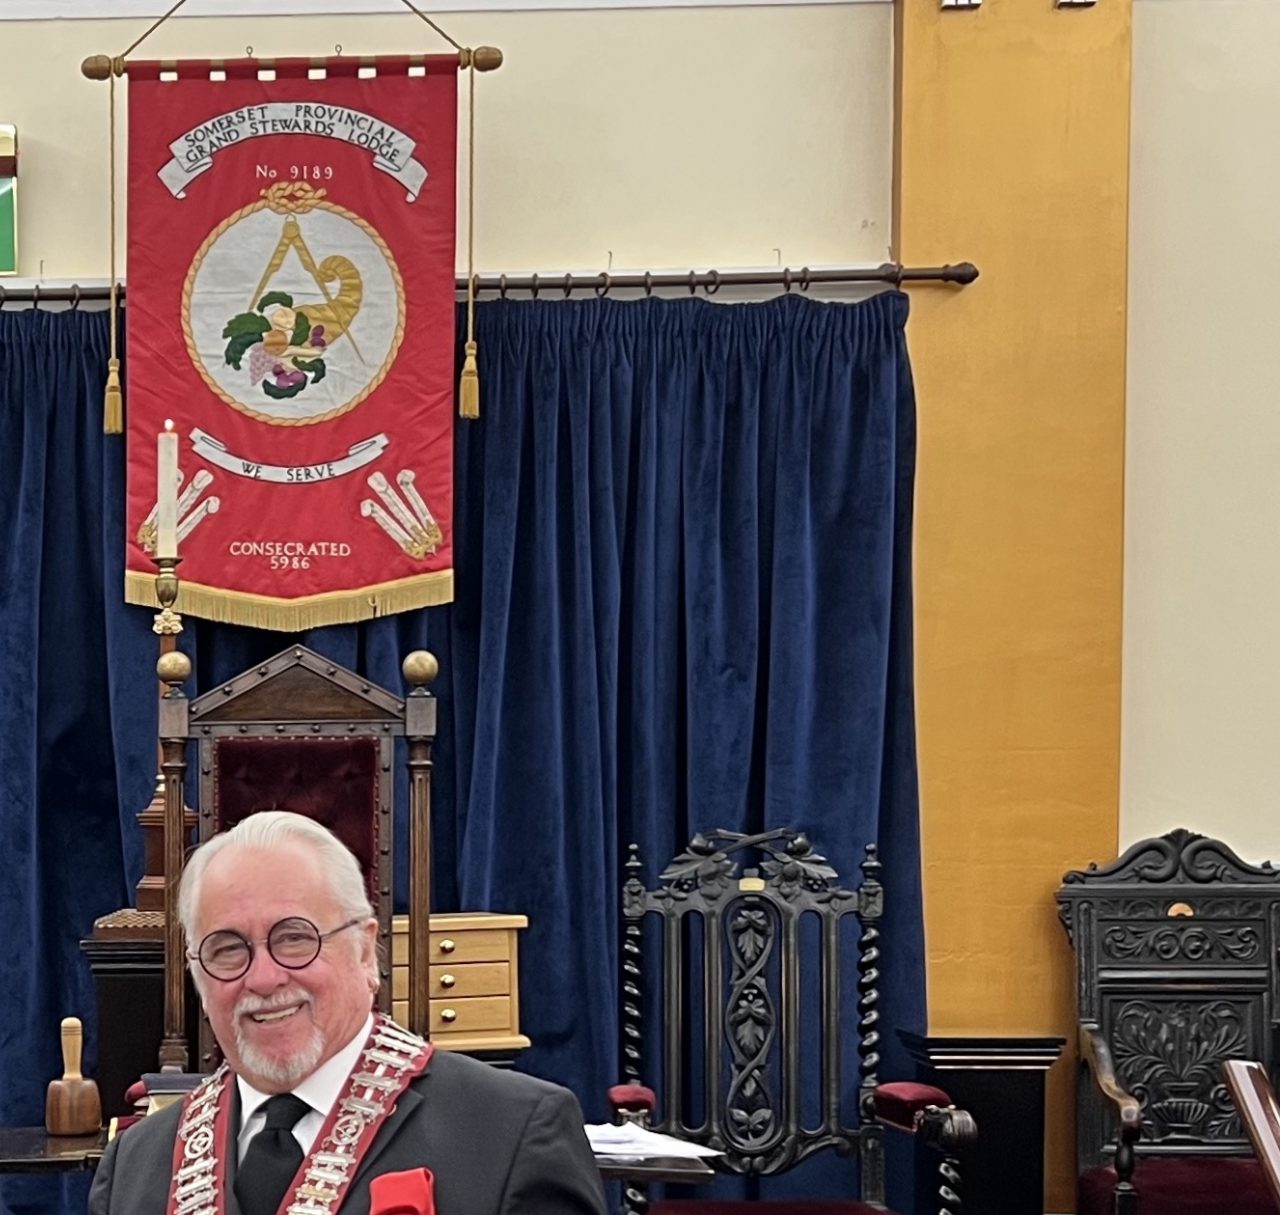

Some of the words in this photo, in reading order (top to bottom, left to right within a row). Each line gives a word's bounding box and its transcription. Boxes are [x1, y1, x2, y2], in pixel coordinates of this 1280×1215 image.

[184, 105, 269, 148] SOMERSET
[295, 104, 396, 145] PROVINCIAL
[185, 129, 240, 163] GRAND
[249, 118, 335, 136] STEWARDS
[347, 123, 400, 162] LODGE
[255, 165, 278, 179] No
[289, 165, 334, 180] 9189
[241, 461, 262, 479] WE
[286, 463, 336, 481] SERVE
[229, 541, 352, 557] CONSECRATED
[270, 556, 311, 570] 5986
